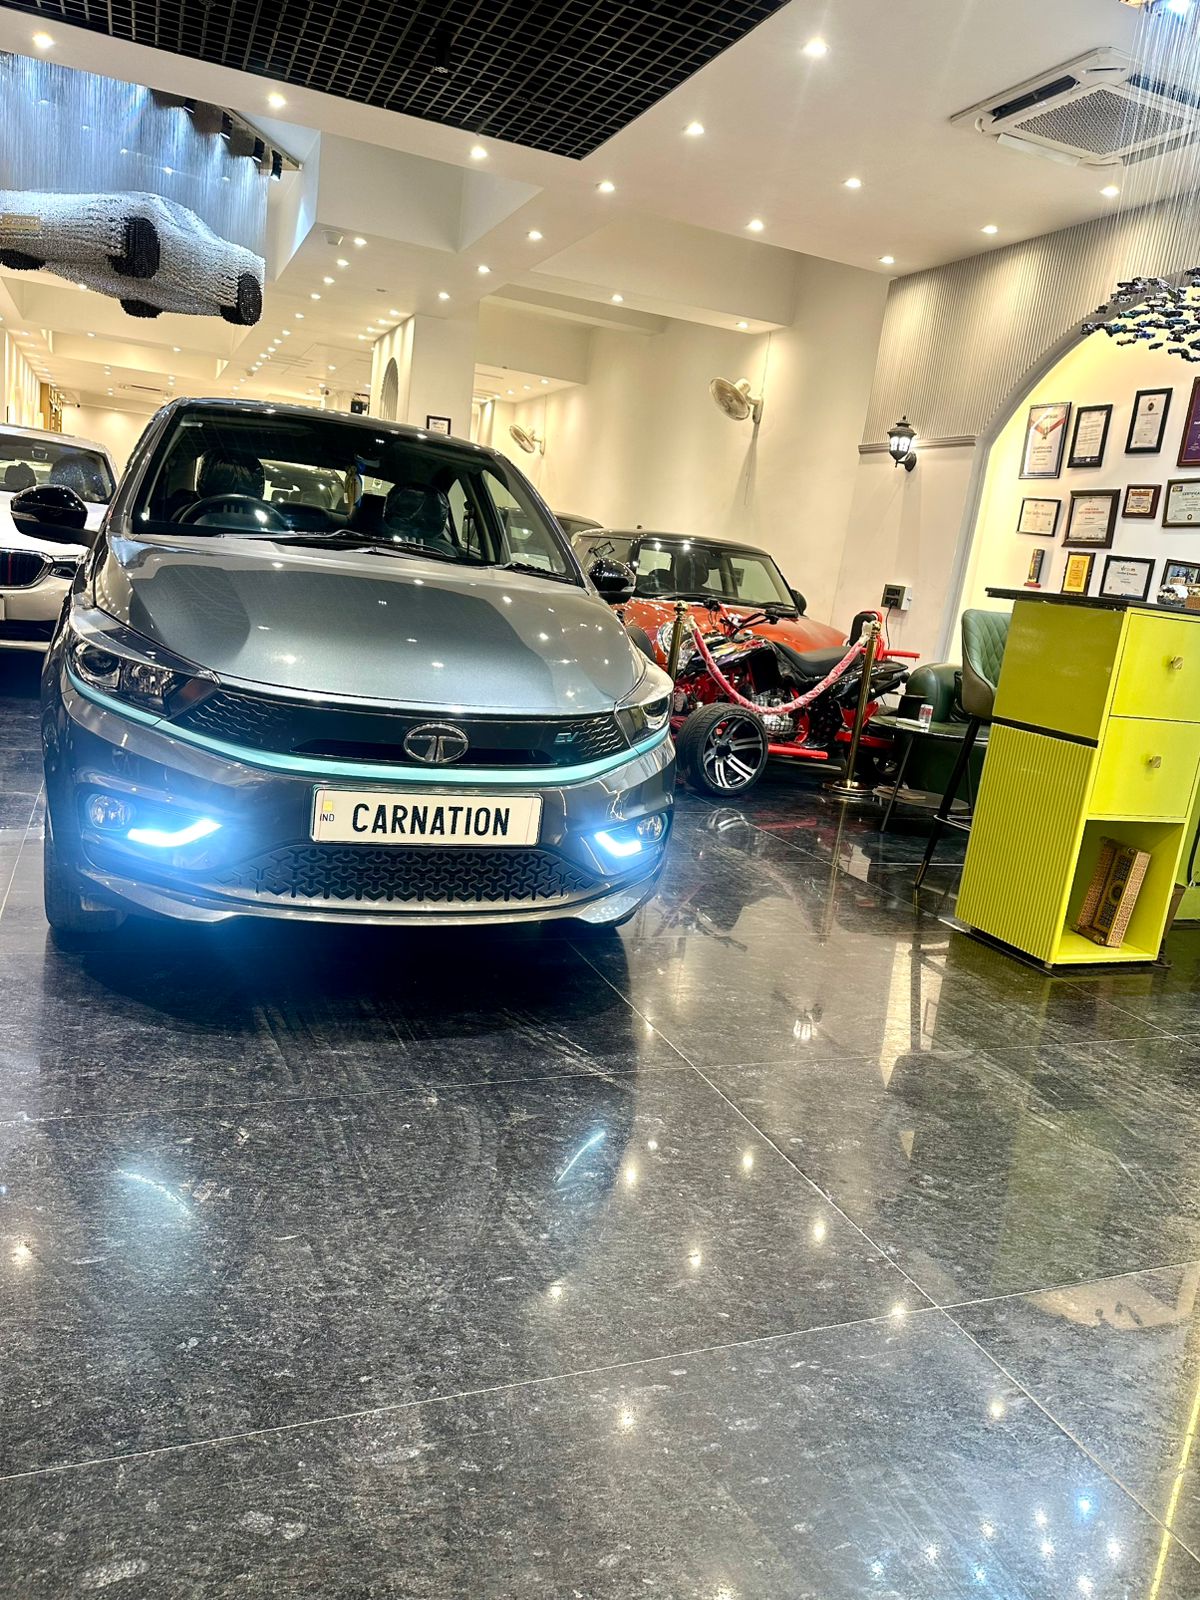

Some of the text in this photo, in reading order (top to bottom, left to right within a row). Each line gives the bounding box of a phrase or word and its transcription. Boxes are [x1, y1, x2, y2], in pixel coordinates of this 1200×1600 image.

[554, 731, 579, 743] EV
[319, 813, 335, 822] IND
[352, 803, 510, 836] CARNATION
